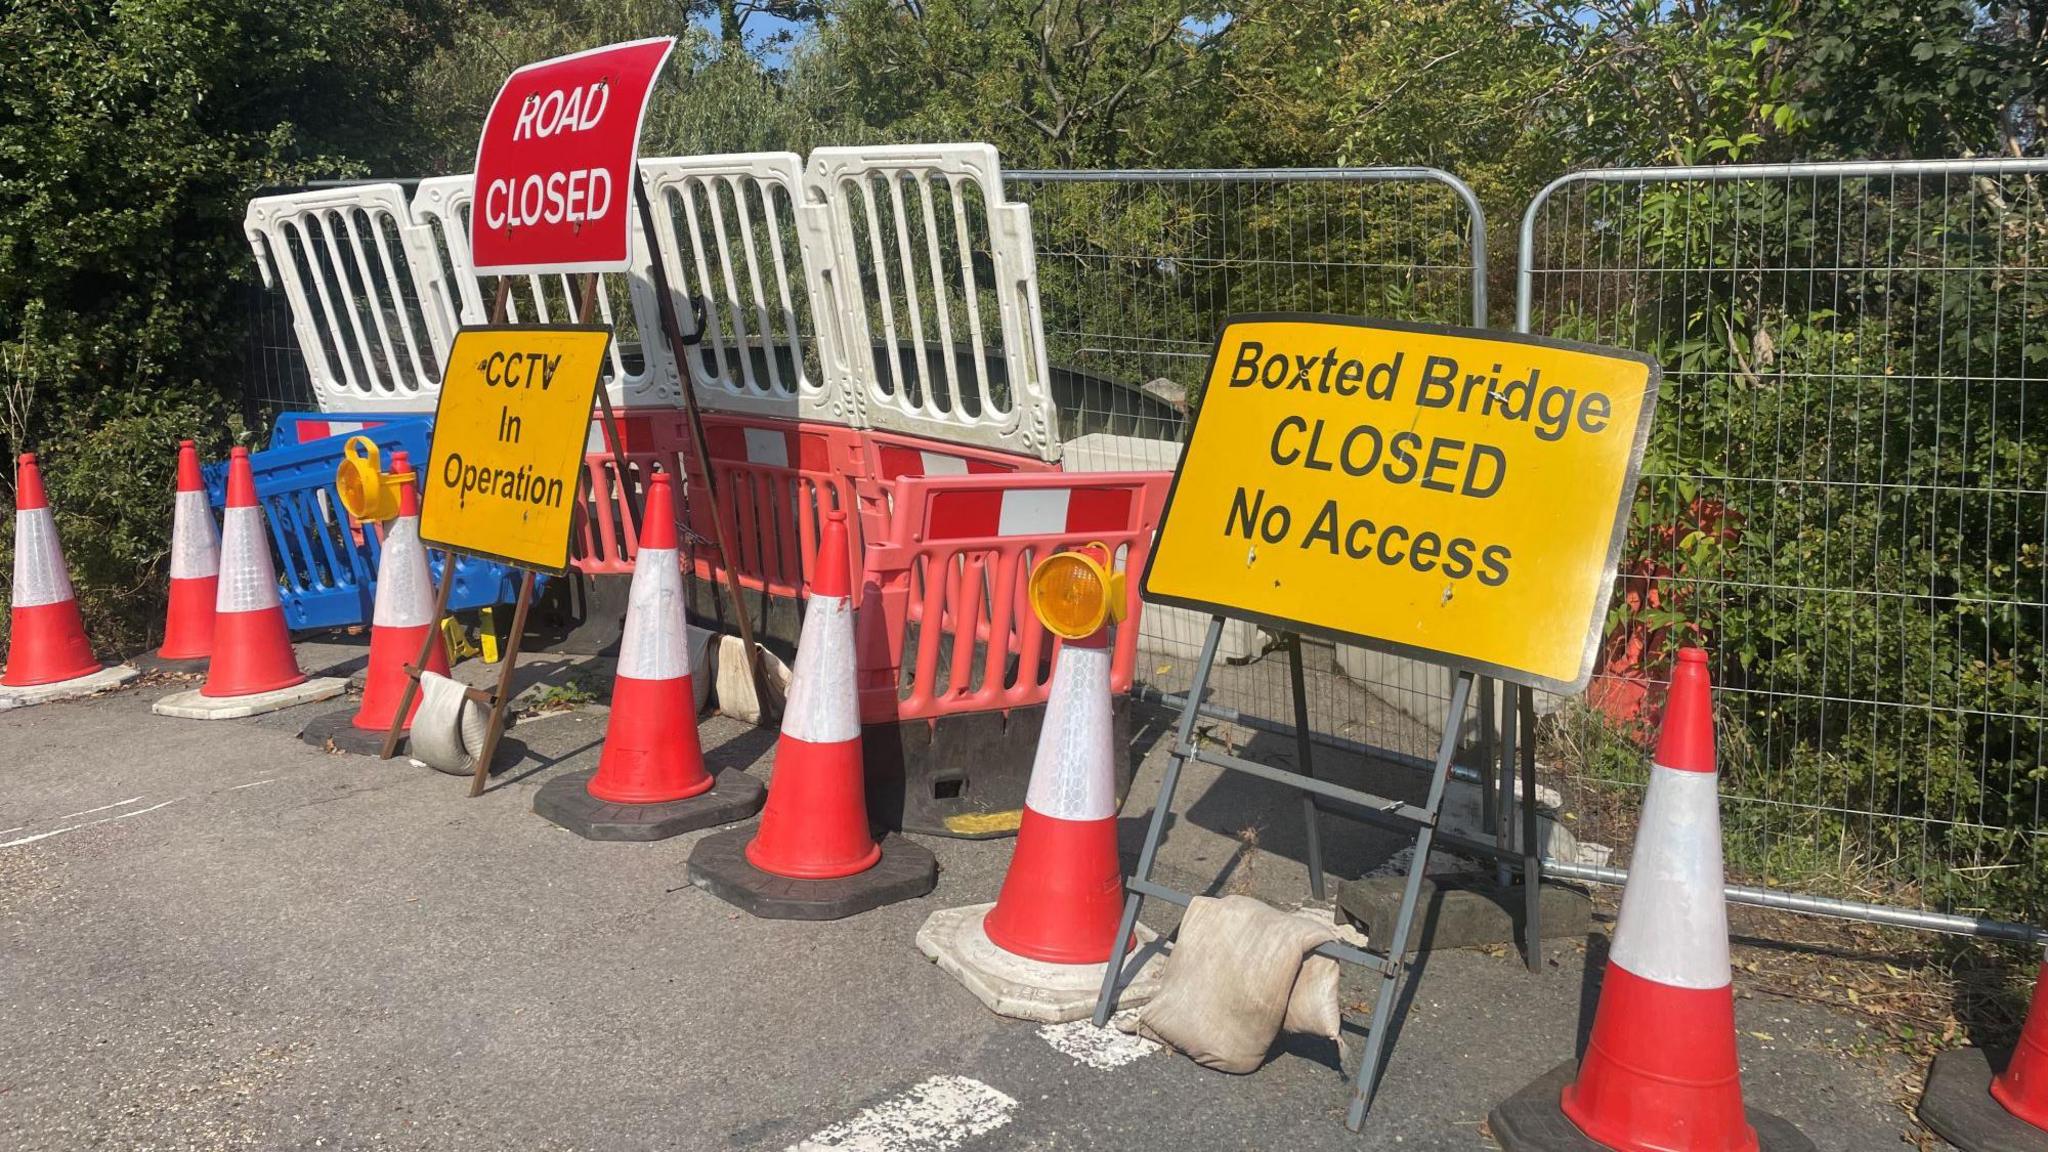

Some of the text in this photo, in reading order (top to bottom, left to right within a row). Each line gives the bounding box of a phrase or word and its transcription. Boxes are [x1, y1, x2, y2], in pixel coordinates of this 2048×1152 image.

[514, 83, 608, 140] ROAD
[486, 168, 611, 229] CLOSED
[486, 352, 560, 390] CCTV
[1229, 341, 1611, 441] Boxted Bridge
[499, 407, 521, 442] In
[443, 453, 563, 508] Operation
[1270, 415, 1506, 499] CLOSED
[1224, 487, 1512, 587] No Access
